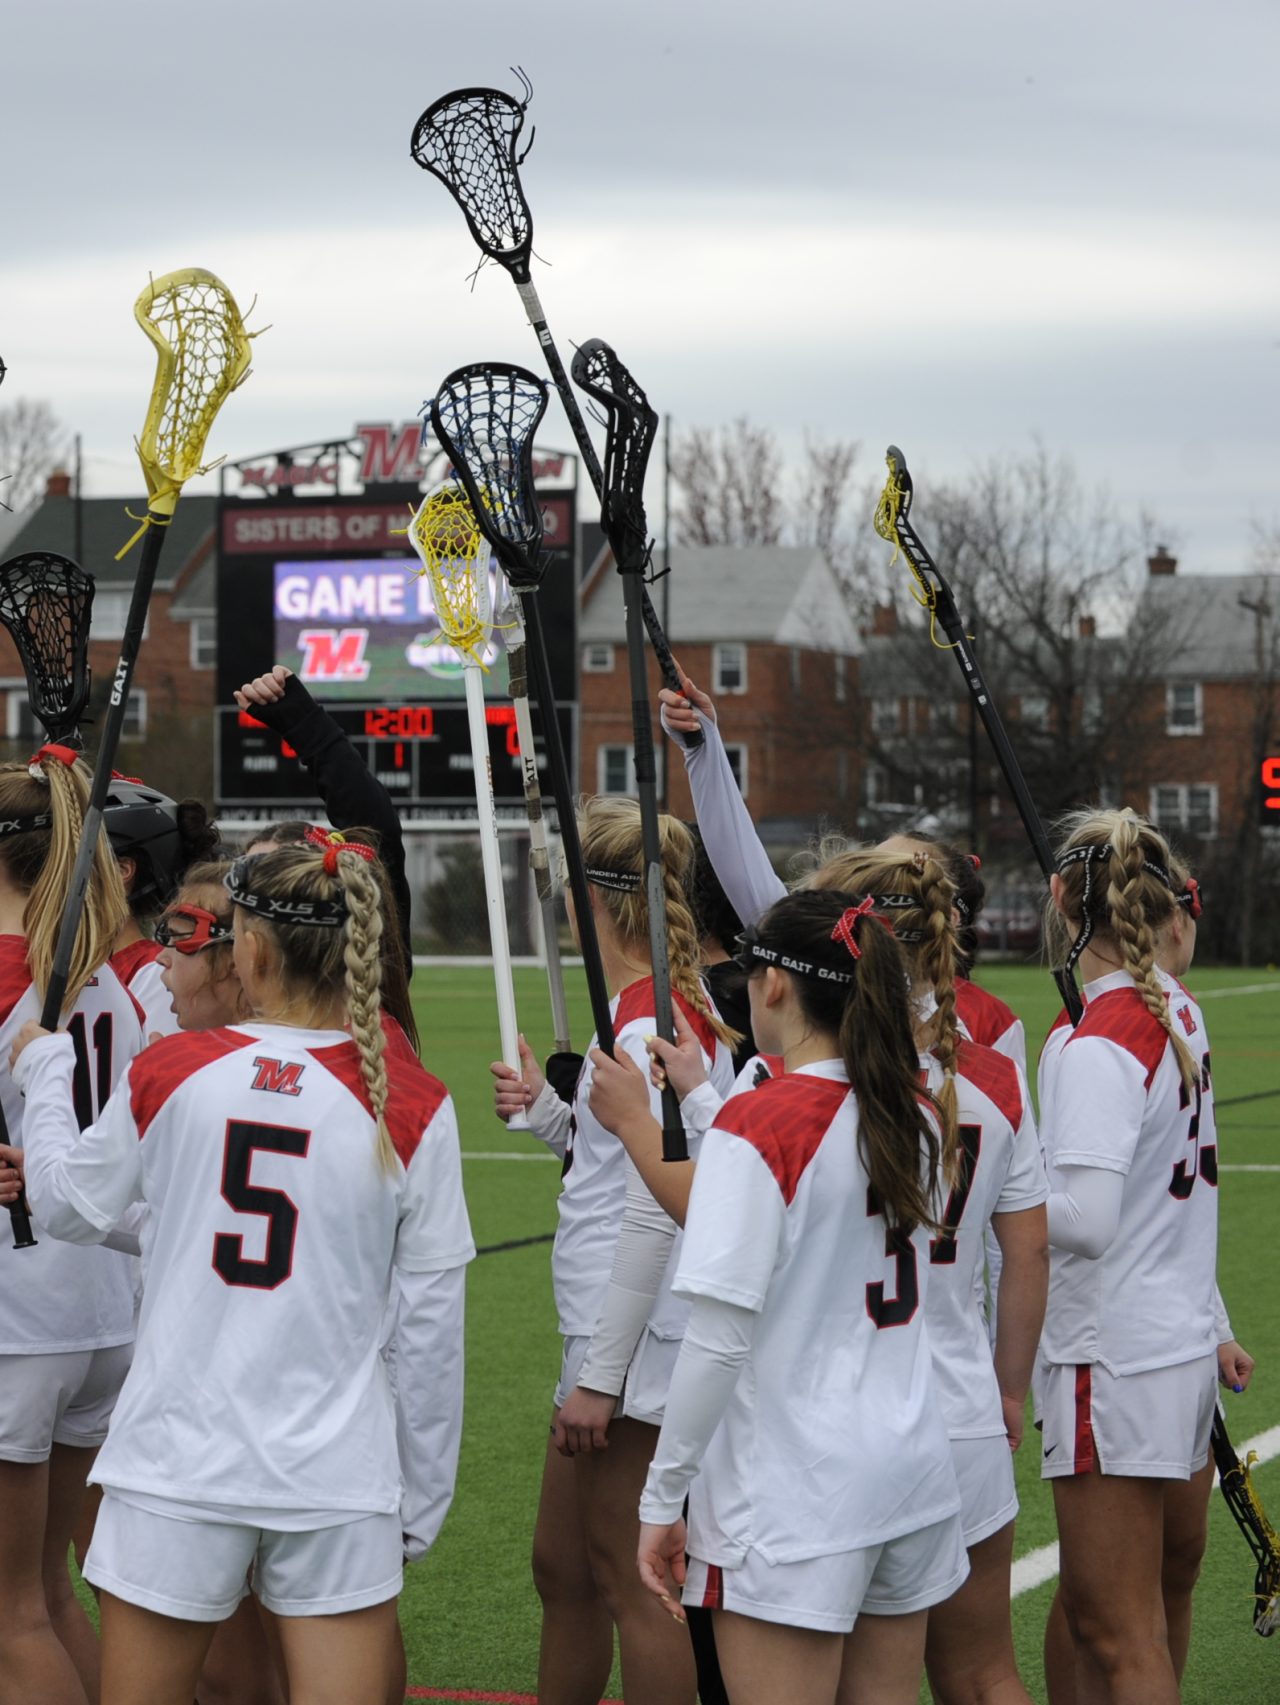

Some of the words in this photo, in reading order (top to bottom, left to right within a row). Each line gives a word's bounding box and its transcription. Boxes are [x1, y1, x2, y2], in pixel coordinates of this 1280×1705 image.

[234, 515, 342, 543] SISTERS
[345, 514, 381, 540] OF
[276, 574, 406, 619] GAME
[110, 656, 129, 706] GAIT
[365, 706, 433, 738] 12:00
[525, 757, 535, 782] AIT
[586, 868, 618, 879] UNDER
[269, 899, 314, 915] STX
[896, 930, 923, 941] ST
[752, 945, 778, 962] GAIT
[781, 956, 813, 974] GAIT
[818, 968, 852, 983] GAIT
[66, 1012, 113, 1135] 11
[212, 1118, 312, 1291] 5
